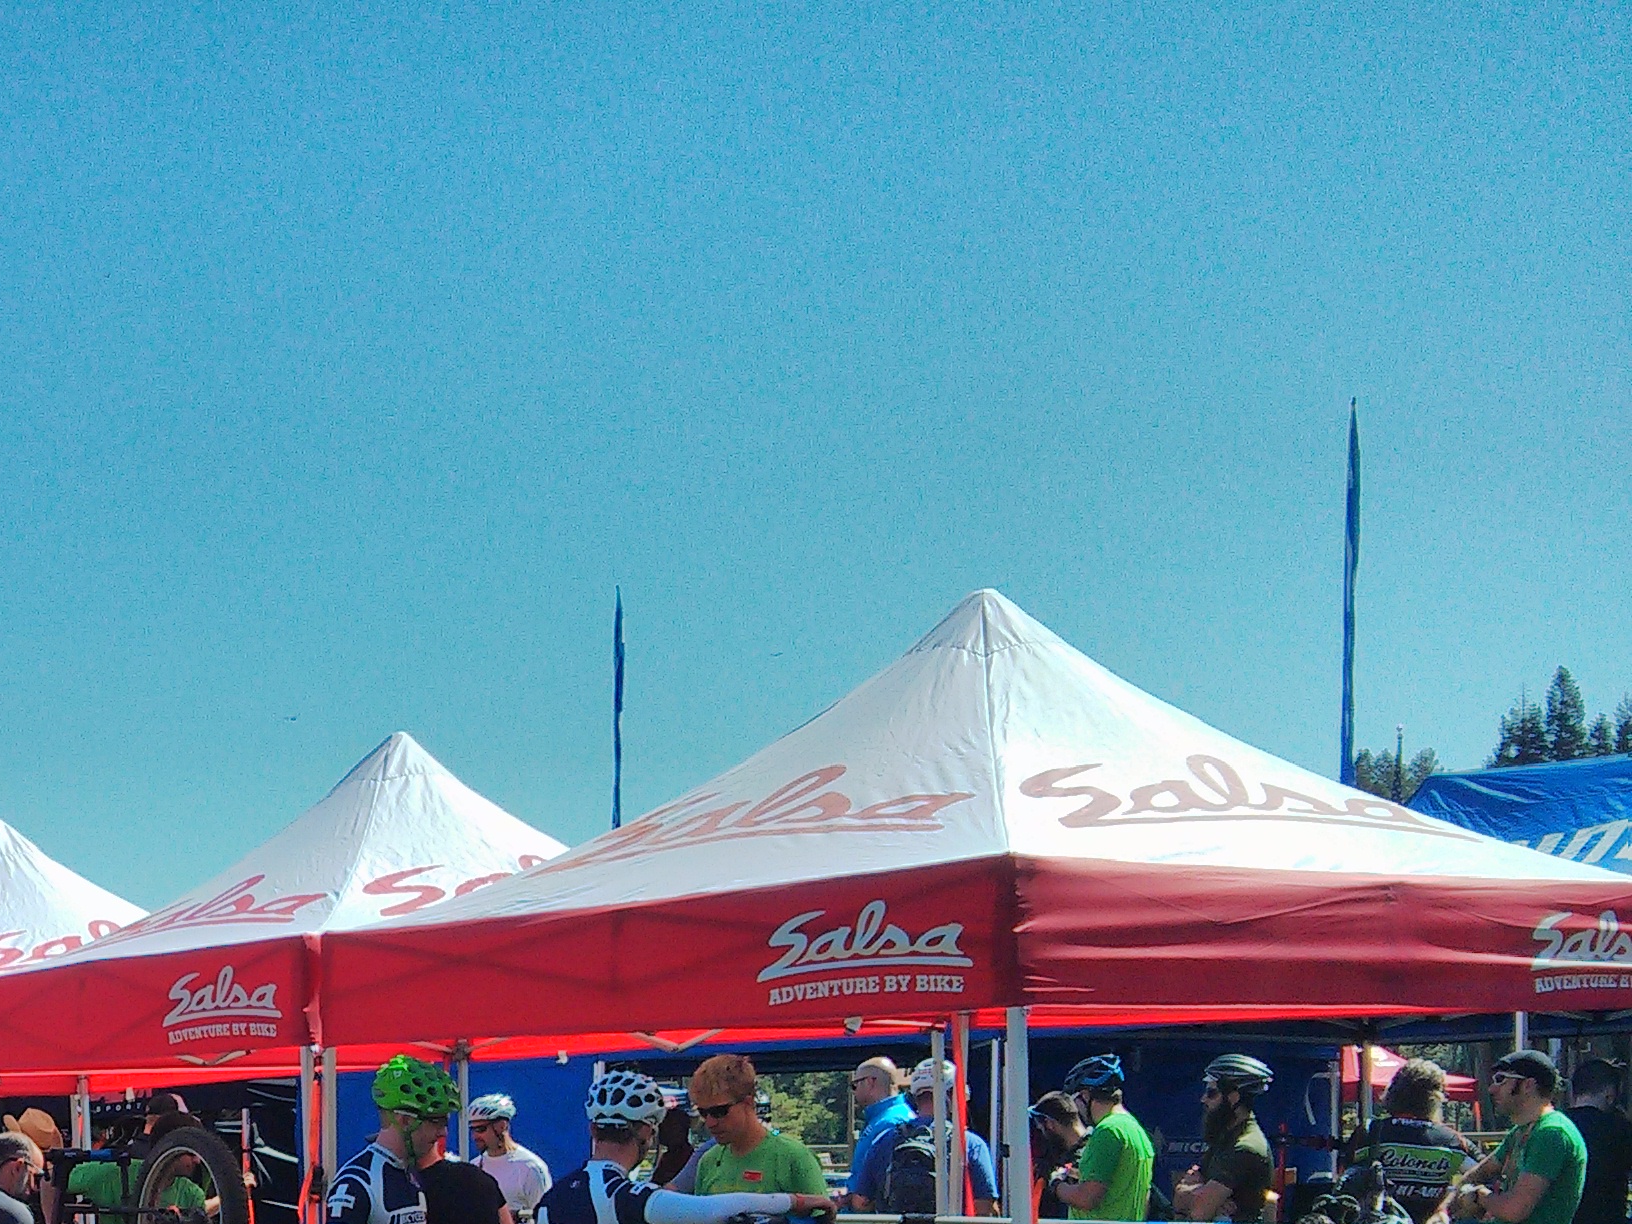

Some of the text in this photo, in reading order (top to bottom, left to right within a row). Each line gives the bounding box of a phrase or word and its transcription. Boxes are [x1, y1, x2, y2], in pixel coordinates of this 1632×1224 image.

[1019, 753, 1484, 843] Salsa
[756, 899, 974, 983] Salsa
[1530, 909, 1632, 971] Sals
[162, 965, 283, 1028] Salsa
[768, 974, 965, 1006] ADVENTURE BY BIKE
[1535, 974, 1618, 994] ADVENTURE
[168, 1022, 277, 1045] ADVENTURE BY BIKE
